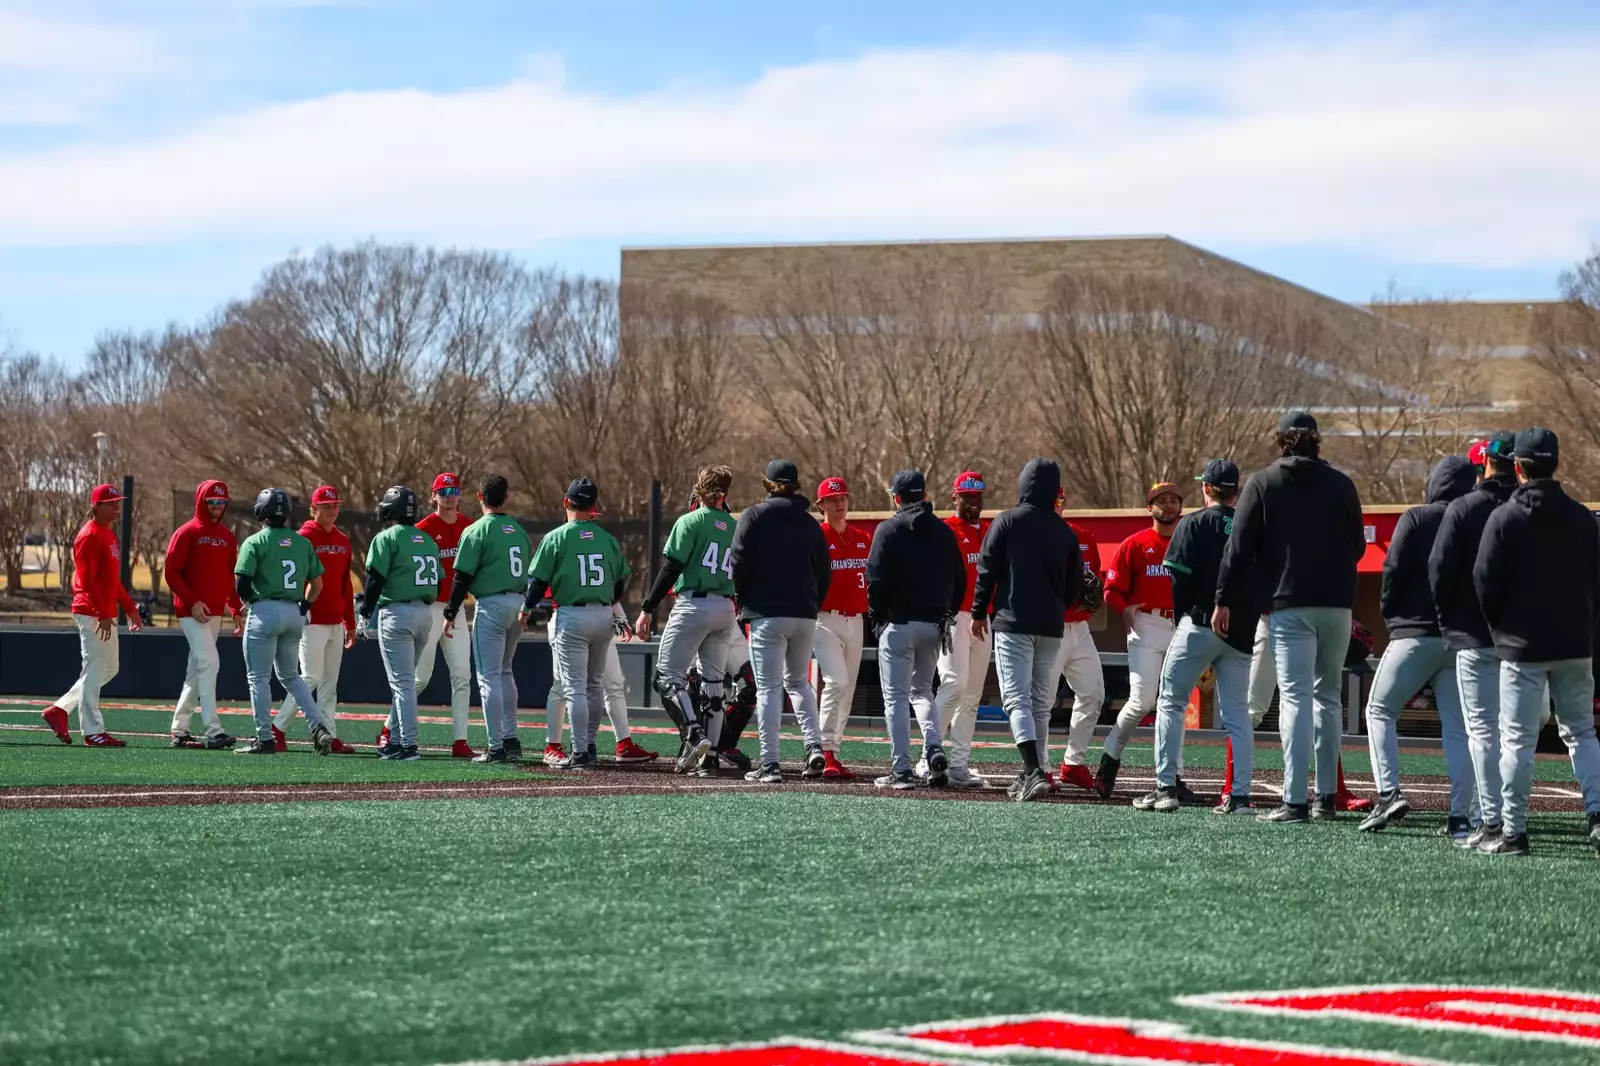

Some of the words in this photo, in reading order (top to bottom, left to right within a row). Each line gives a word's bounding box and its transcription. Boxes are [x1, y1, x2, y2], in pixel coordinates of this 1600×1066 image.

[281, 559, 298, 590] 2
[412, 555, 439, 586] 23
[508, 545, 523, 578] 6
[577, 553, 605, 587] 15
[701, 541, 733, 581] 44
